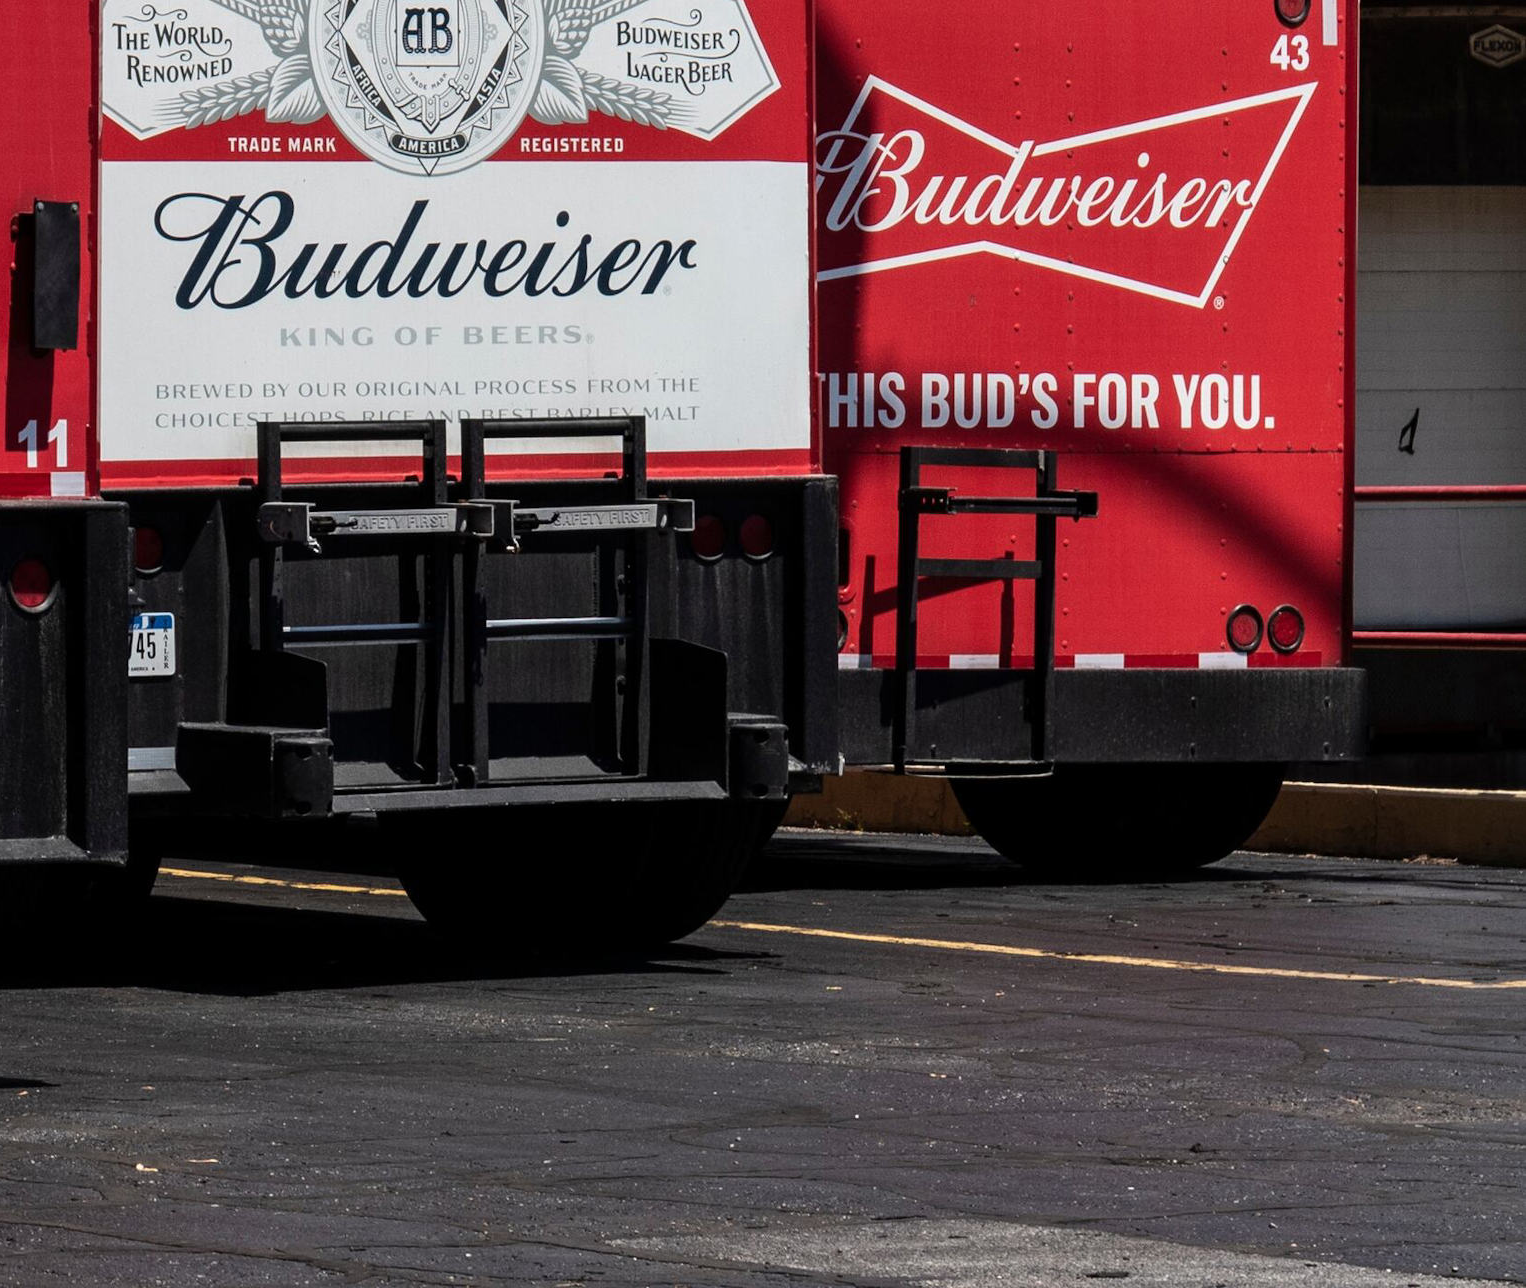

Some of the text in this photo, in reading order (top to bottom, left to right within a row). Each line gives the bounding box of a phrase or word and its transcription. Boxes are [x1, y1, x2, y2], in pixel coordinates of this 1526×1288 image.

[402, 7, 453, 53] AB
[1270, 34, 1311, 71] 43
[352, 64, 382, 107] AFRICA
[477, 67, 503, 106] ASIA
[228, 136, 337, 153] TRADE MARK
[398, 137, 460, 154] AMERICA
[520, 137, 624, 153] REGISTERED
[816, 129, 1253, 232] Budweiser
[154, 190, 697, 310] Budweiser
[280, 326, 375, 347] KING
[394, 325, 443, 346] OF
[155, 378, 701, 400] BREWED BY OUR ORIGINAL PROCESS FROM THE
[921, 372, 1277, 430] BUD'S FOR YOU.
[155, 405, 701, 428] CHOICEST MALT
[18, 418, 68, 468] 11
